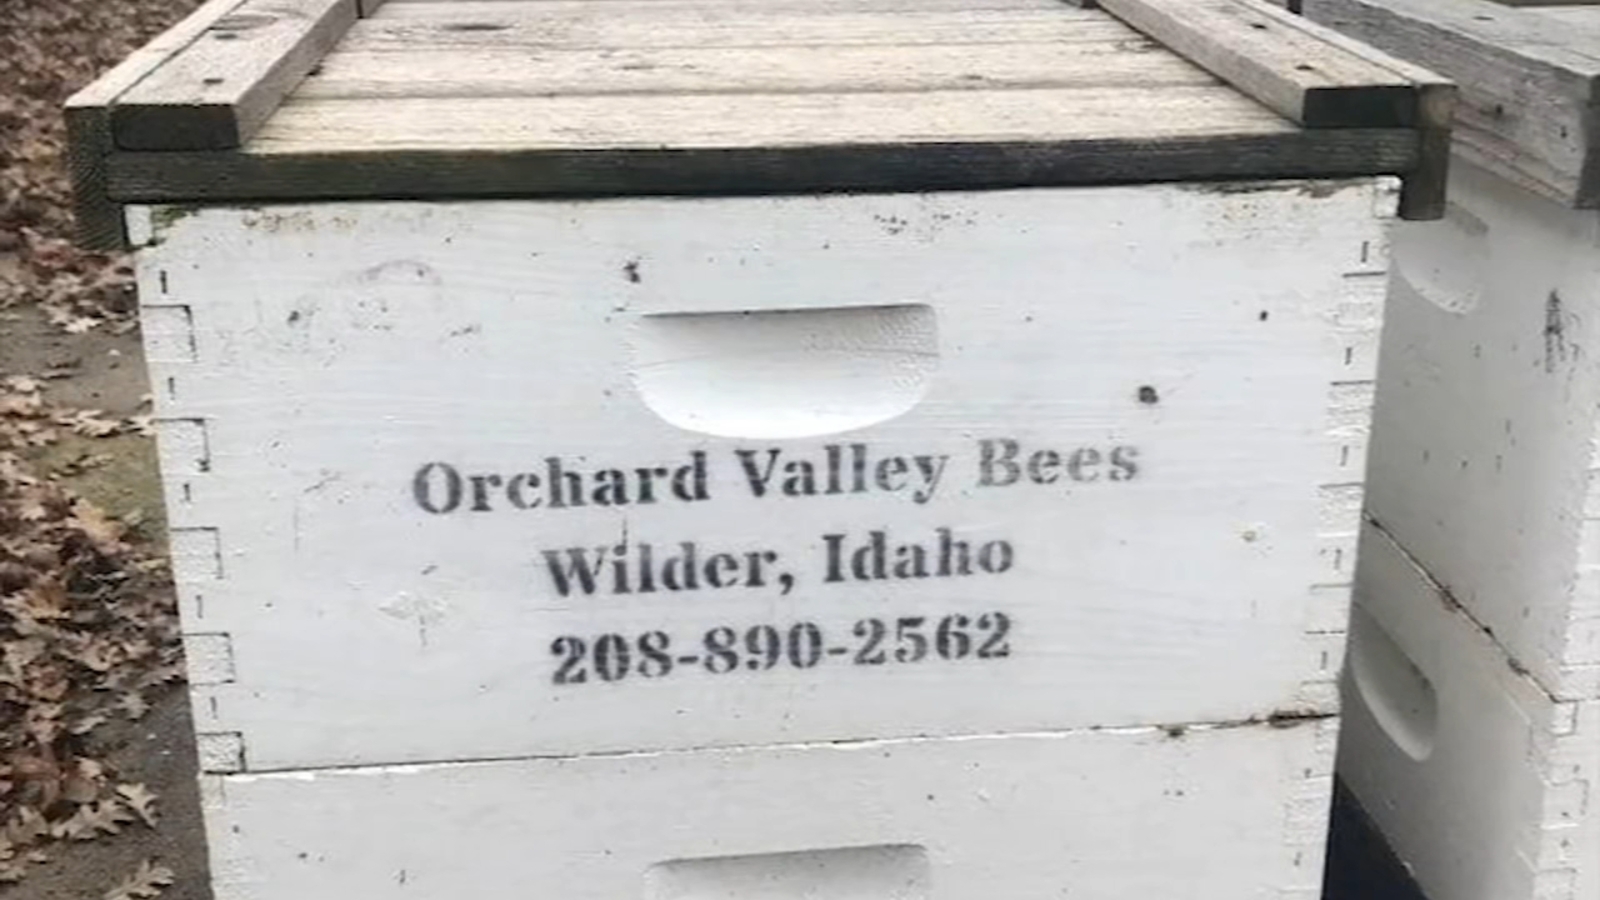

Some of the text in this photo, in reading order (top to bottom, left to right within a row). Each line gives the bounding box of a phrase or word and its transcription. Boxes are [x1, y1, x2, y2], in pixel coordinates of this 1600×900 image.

[412, 438, 1139, 515] Orchard Valley Bees
[541, 527, 1015, 598] Wilder, Idaho
[549, 611, 1012, 685] 208-890-2562
